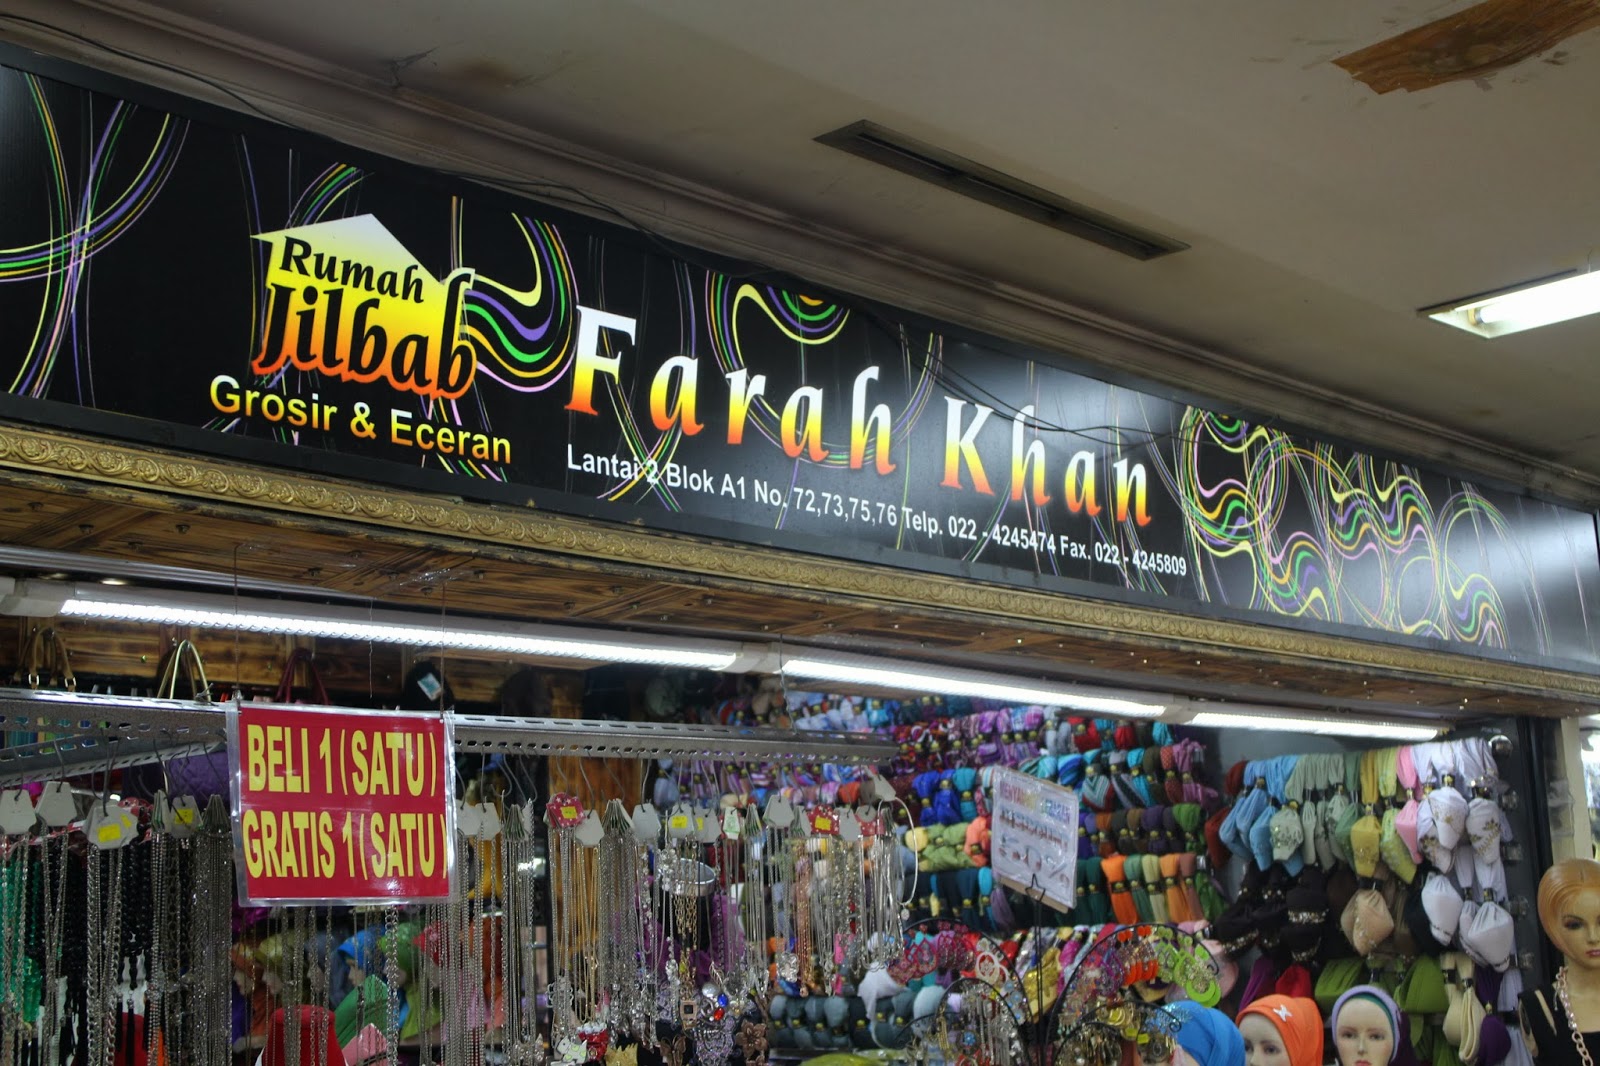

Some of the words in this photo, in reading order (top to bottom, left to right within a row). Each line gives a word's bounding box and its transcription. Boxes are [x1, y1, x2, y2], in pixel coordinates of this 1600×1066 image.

[279, 236, 425, 304] Rumah
[257, 271, 474, 393] Jilbab
[209, 375, 338, 431] Grosir
[349, 401, 377, 440] &
[390, 408, 512, 465] Eceran
[564, 305, 897, 476] Farah
[940, 395, 1152, 527] Khan
[567, 443, 640, 482] Lantai
[646, 458, 659, 485] 2
[666, 462, 715, 494] Blok
[720, 473, 746, 500] A1
[754, 479, 788, 509] No.
[794, 486, 897, 528] 72,73,75,76
[902, 506, 943, 538] Telp.
[948, 515, 977, 541] 022
[992, 526, 1057, 556] 4245474
[1060, 536, 1092, 561] Fax.
[1094, 541, 1120, 566] 022
[1131, 550, 1187, 577] 4245809
[247, 723, 311, 794] BELI
[242, 809, 336, 879] GRATIS
